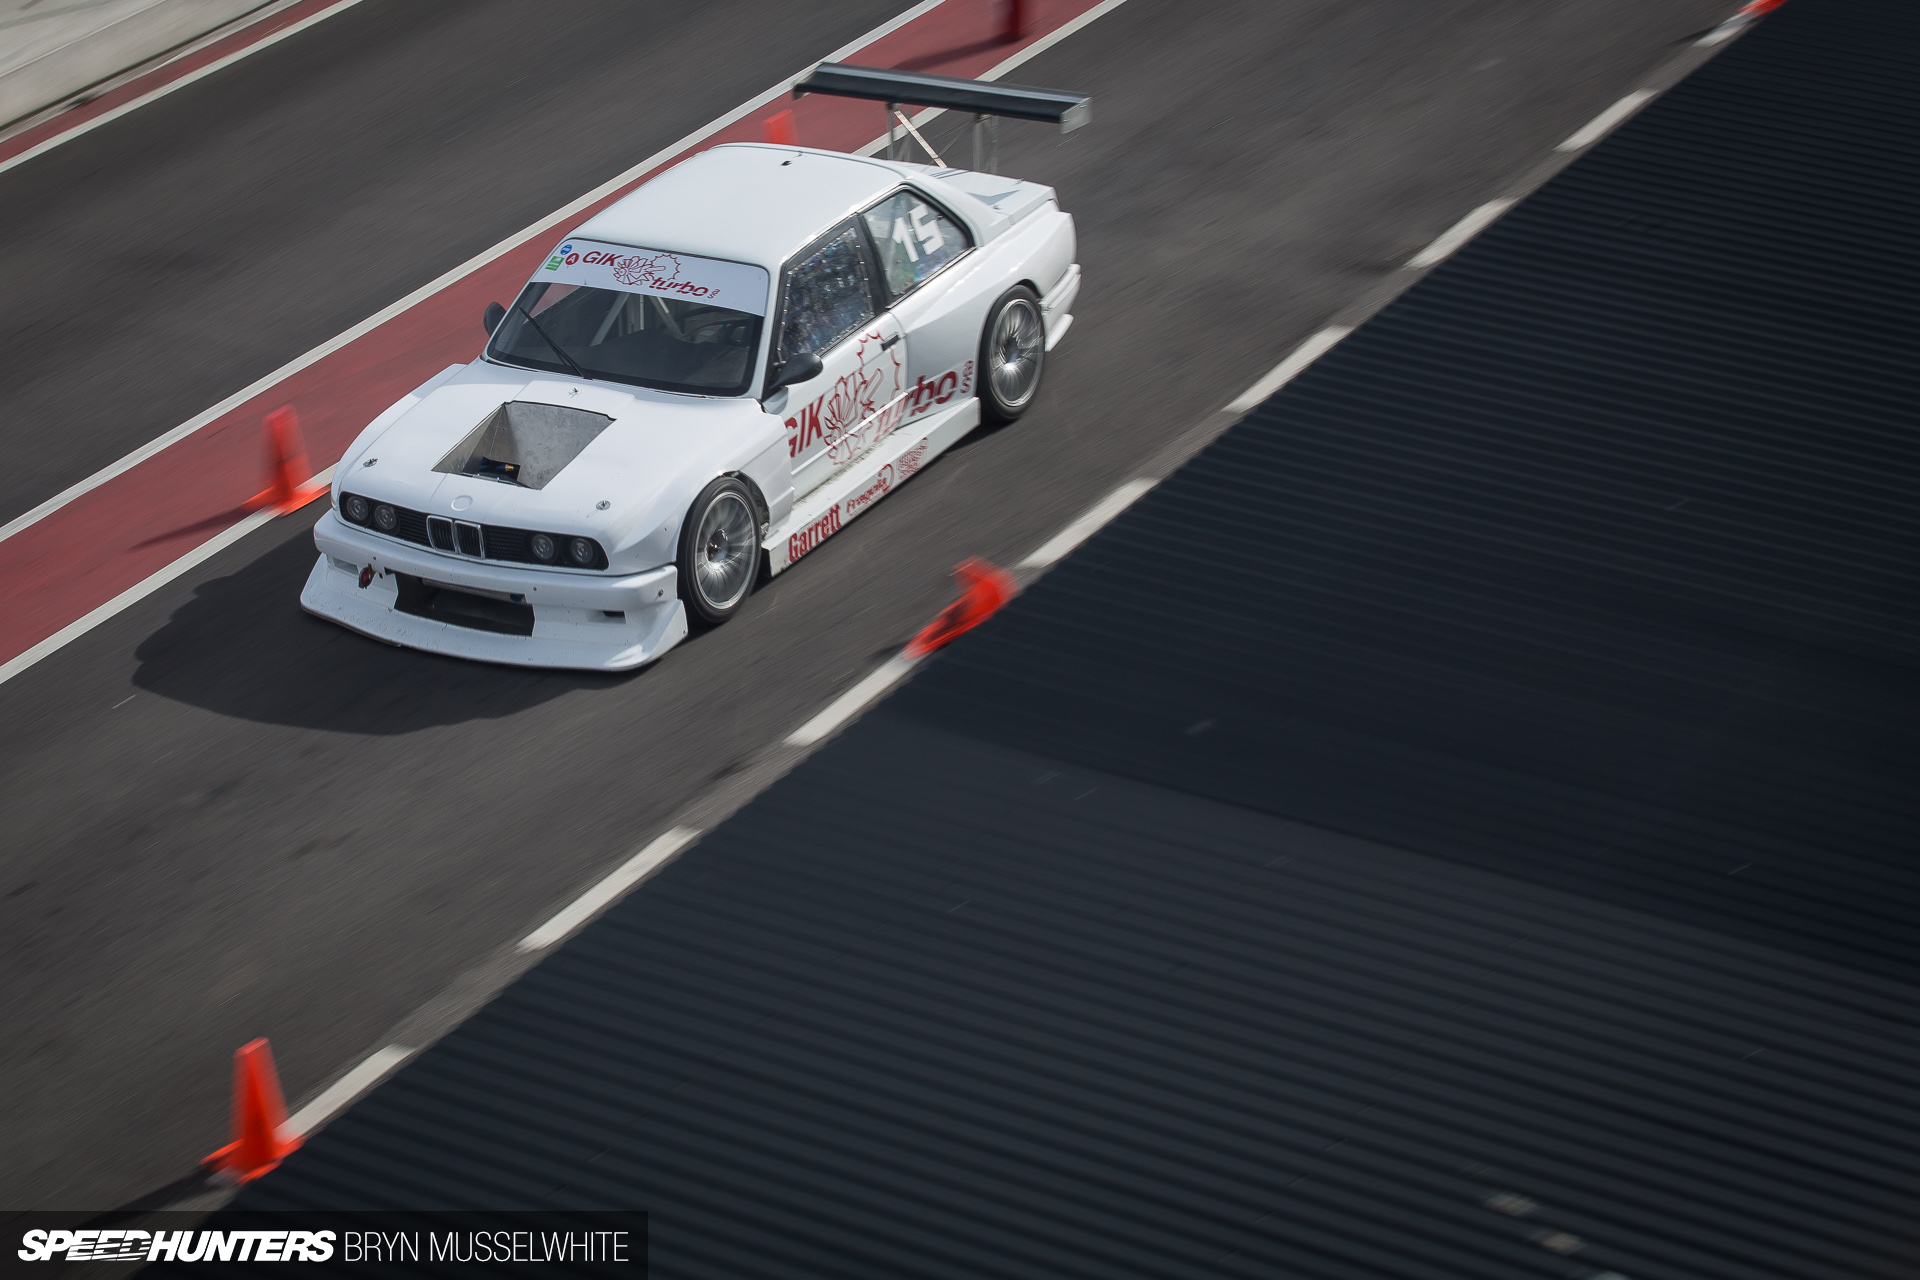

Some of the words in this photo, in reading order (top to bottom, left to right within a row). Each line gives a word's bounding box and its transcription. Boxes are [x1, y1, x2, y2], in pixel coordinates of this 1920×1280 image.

[582, 251, 625, 267] GIK
[892, 203, 945, 262] 15
[649, 277, 709, 296] turbo
[785, 395, 825, 458] GIK
[873, 371, 959, 442] turbo
[788, 503, 842, 563] Garrett
